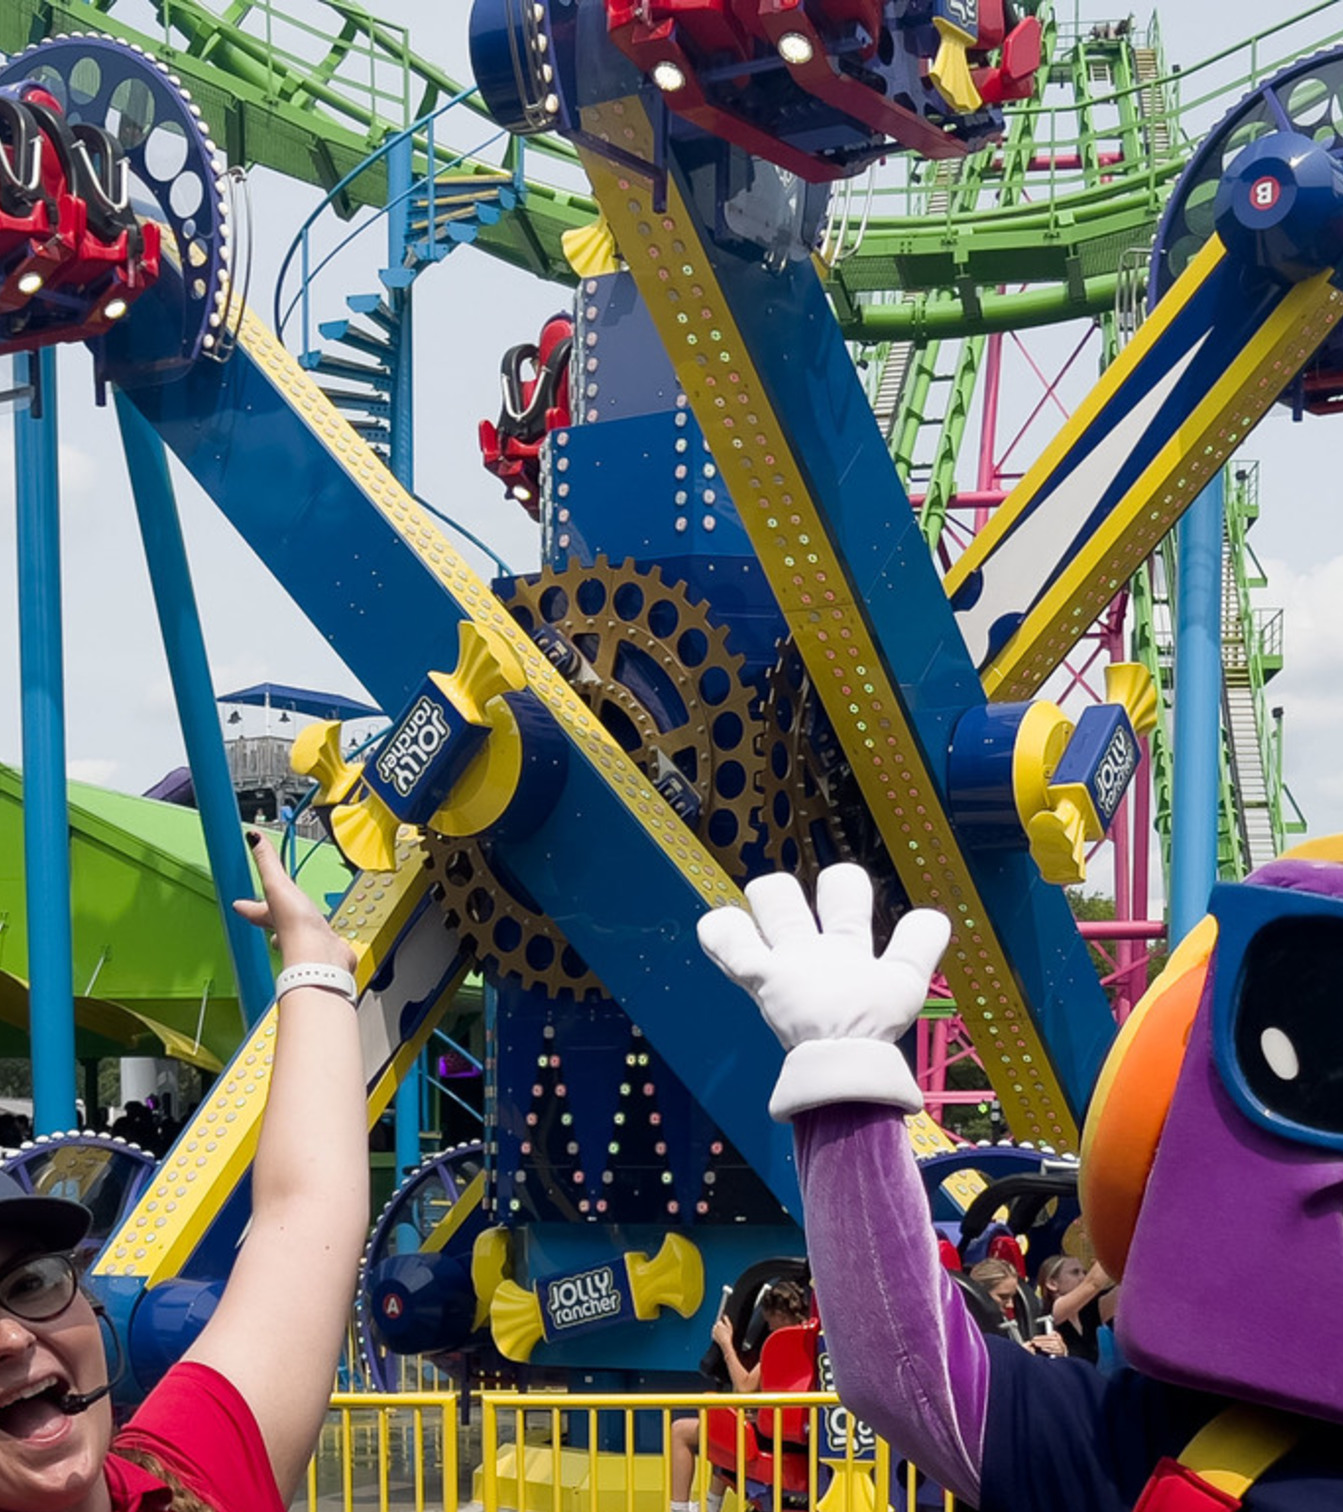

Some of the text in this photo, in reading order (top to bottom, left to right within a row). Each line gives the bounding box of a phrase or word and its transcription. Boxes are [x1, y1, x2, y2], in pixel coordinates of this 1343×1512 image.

[1256, 181, 1273, 205] B
[380, 701, 431, 778] rancher
[394, 709, 448, 791] JOLLY
[1097, 731, 1126, 802] JOLLY
[386, 1297, 400, 1314] A
[551, 1270, 611, 1310] JOLLY
[556, 1294, 619, 1325] rancher
